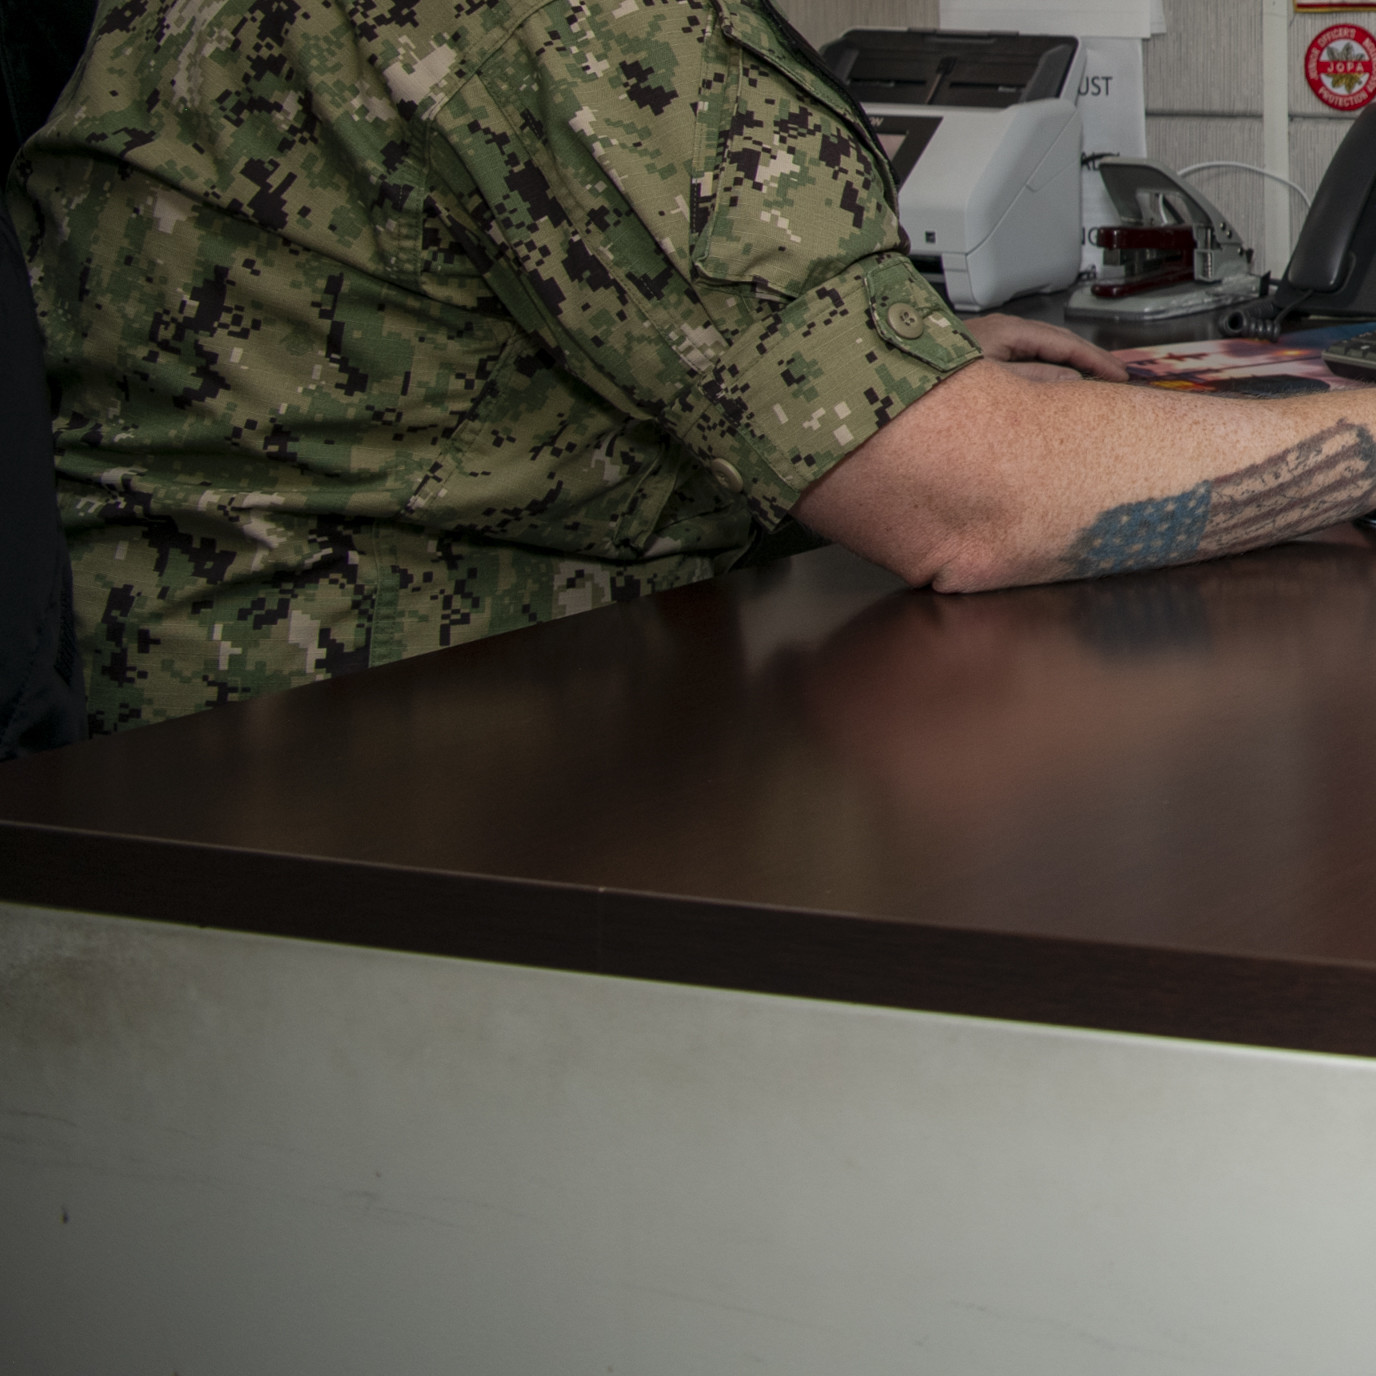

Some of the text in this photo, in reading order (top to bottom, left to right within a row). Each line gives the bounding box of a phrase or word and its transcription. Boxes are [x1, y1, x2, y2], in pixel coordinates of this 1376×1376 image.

[1308, 47, 1321, 81] JUNIOR
[1327, 62, 1364, 73] JOPA
[1078, 76, 1112, 96] UST
[1318, 86, 1368, 107] PROTECTION
